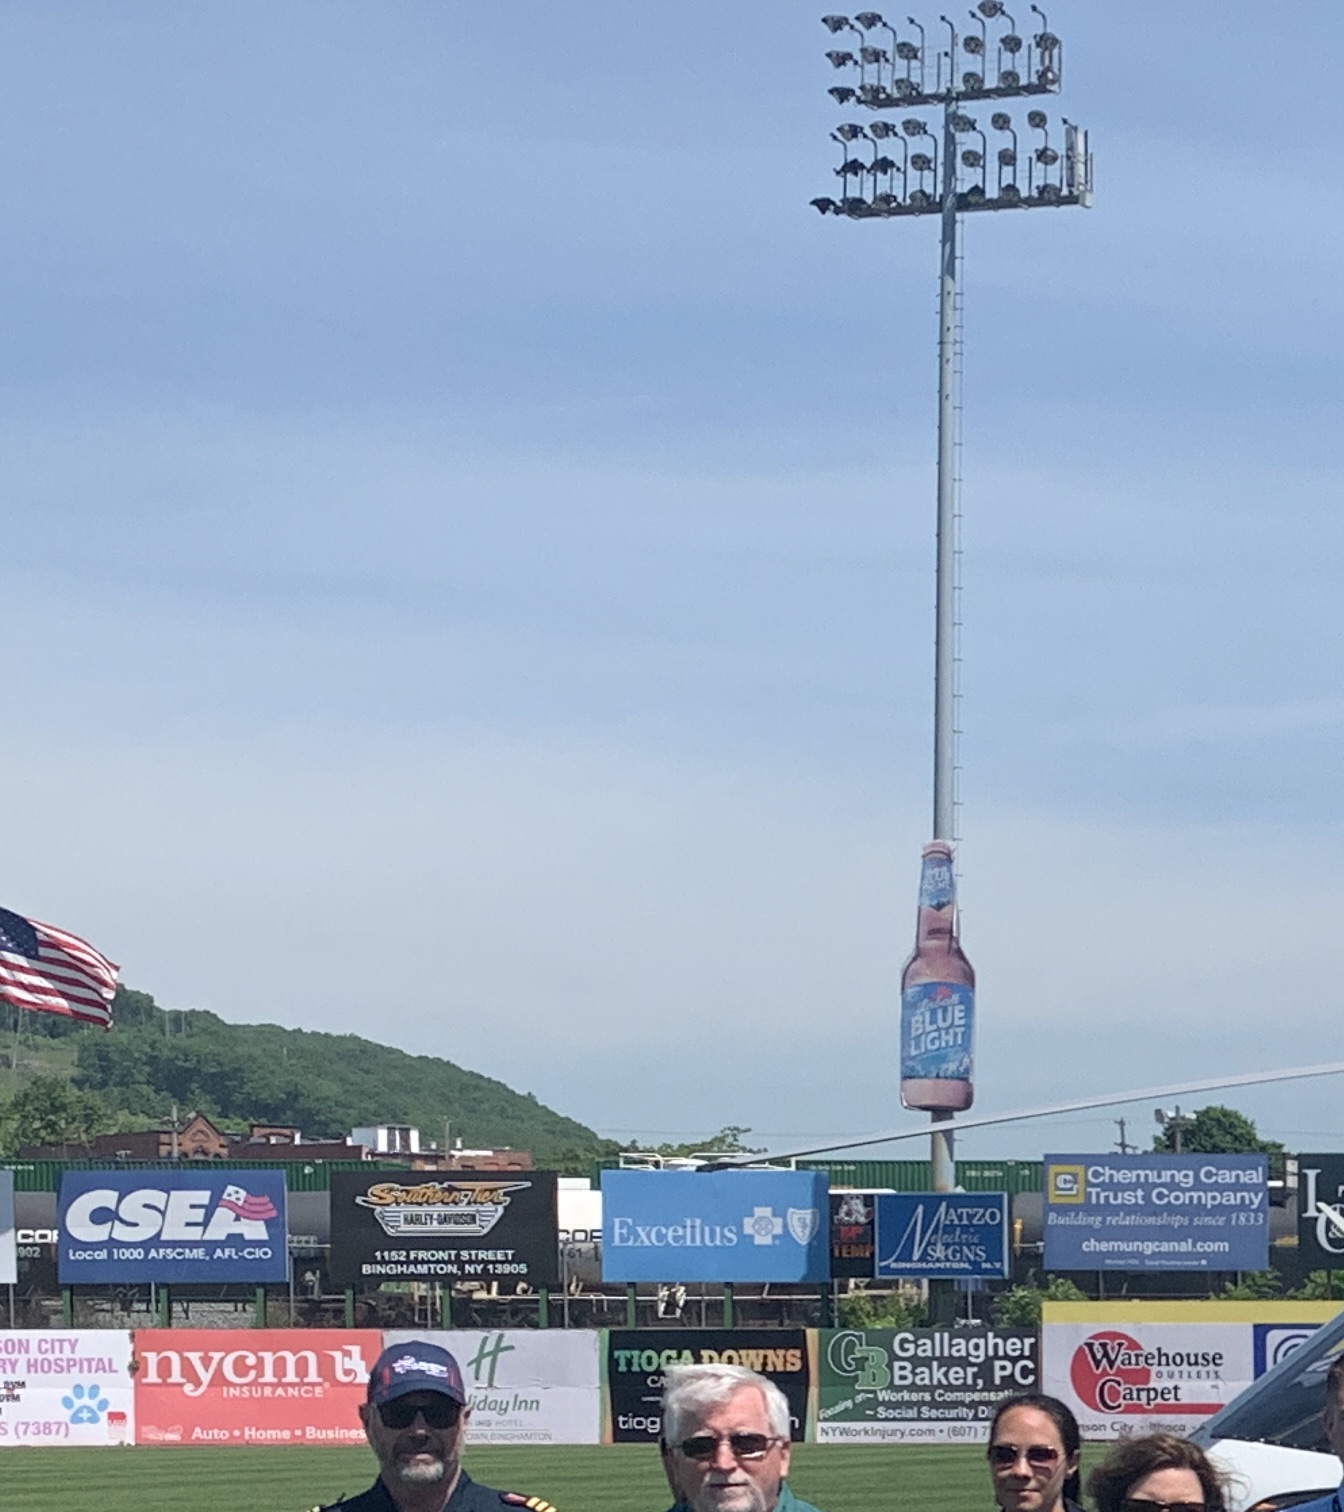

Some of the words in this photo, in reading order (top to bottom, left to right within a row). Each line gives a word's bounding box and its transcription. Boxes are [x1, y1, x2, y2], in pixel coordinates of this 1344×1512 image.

[910, 1003, 967, 1038] BLUE
[909, 1026, 966, 1057] LIGHT
[1086, 1165, 1194, 1188] Chemung
[1199, 1165, 1264, 1184] Canal
[1086, 1187, 1146, 1205] Trust
[1151, 1187, 1264, 1210] Company
[65, 1188, 269, 1242] CSEA
[402, 1212, 478, 1226] HARLEY-DAVIDSON
[1047, 1212, 1103, 1229] Building
[1105, 1212, 1190, 1229] relationships
[1192, 1212, 1227, 1227] since
[1230, 1212, 1265, 1227] 1833
[611, 1217, 738, 1247] Excellus
[69, 1247, 108, 1260] Local
[113, 1247, 144, 1260] 1000
[149, 1247, 210, 1261] AFSCME,
[213, 1247, 273, 1260] AFL-CIO
[926, 1244, 987, 1262] SIGNS
[1081, 1238, 1231, 1255] chemungcanal.com
[409, 1250, 457, 1261] FRONT
[459, 1250, 515, 1261] STREET
[361, 1264, 462, 1277] BINGHAMTON,
[464, 1264, 486, 1275] NY
[487, 1264, 529, 1275] 13905
[37, 1338, 79, 1355] CITY
[892, 1331, 1036, 1364] Gallagher
[614, 1350, 695, 1372] TIOGA
[701, 1350, 803, 1372] DOWNS
[1083, 1341, 1224, 1372] Warehouse
[26, 1357, 119, 1374] HOSPITAL
[140, 1349, 324, 1398] nycm
[892, 1360, 984, 1389] Baker,
[993, 1359, 1036, 1386] PC
[1155, 1369, 1221, 1380] OUTLETS
[222, 1385, 324, 1398] INSURANCE
[876, 1389, 932, 1402] Workers
[934, 1388, 1016, 1404] Compensati
[1097, 1378, 1182, 1411] Carpet
[512, 1394, 540, 1412] Inn
[876, 1406, 918, 1419] Social
[920, 1406, 976, 1421] Security
[14, 1420, 70, 1439] (7387)
[191, 1426, 230, 1441] Auto
[243, 1426, 291, 1441] Home
[305, 1426, 367, 1441] Busines
[820, 1426, 936, 1442] NYWorkInjury.com
[946, 1425, 978, 1439] (607)
[1110, 1421, 1135, 1433] City
